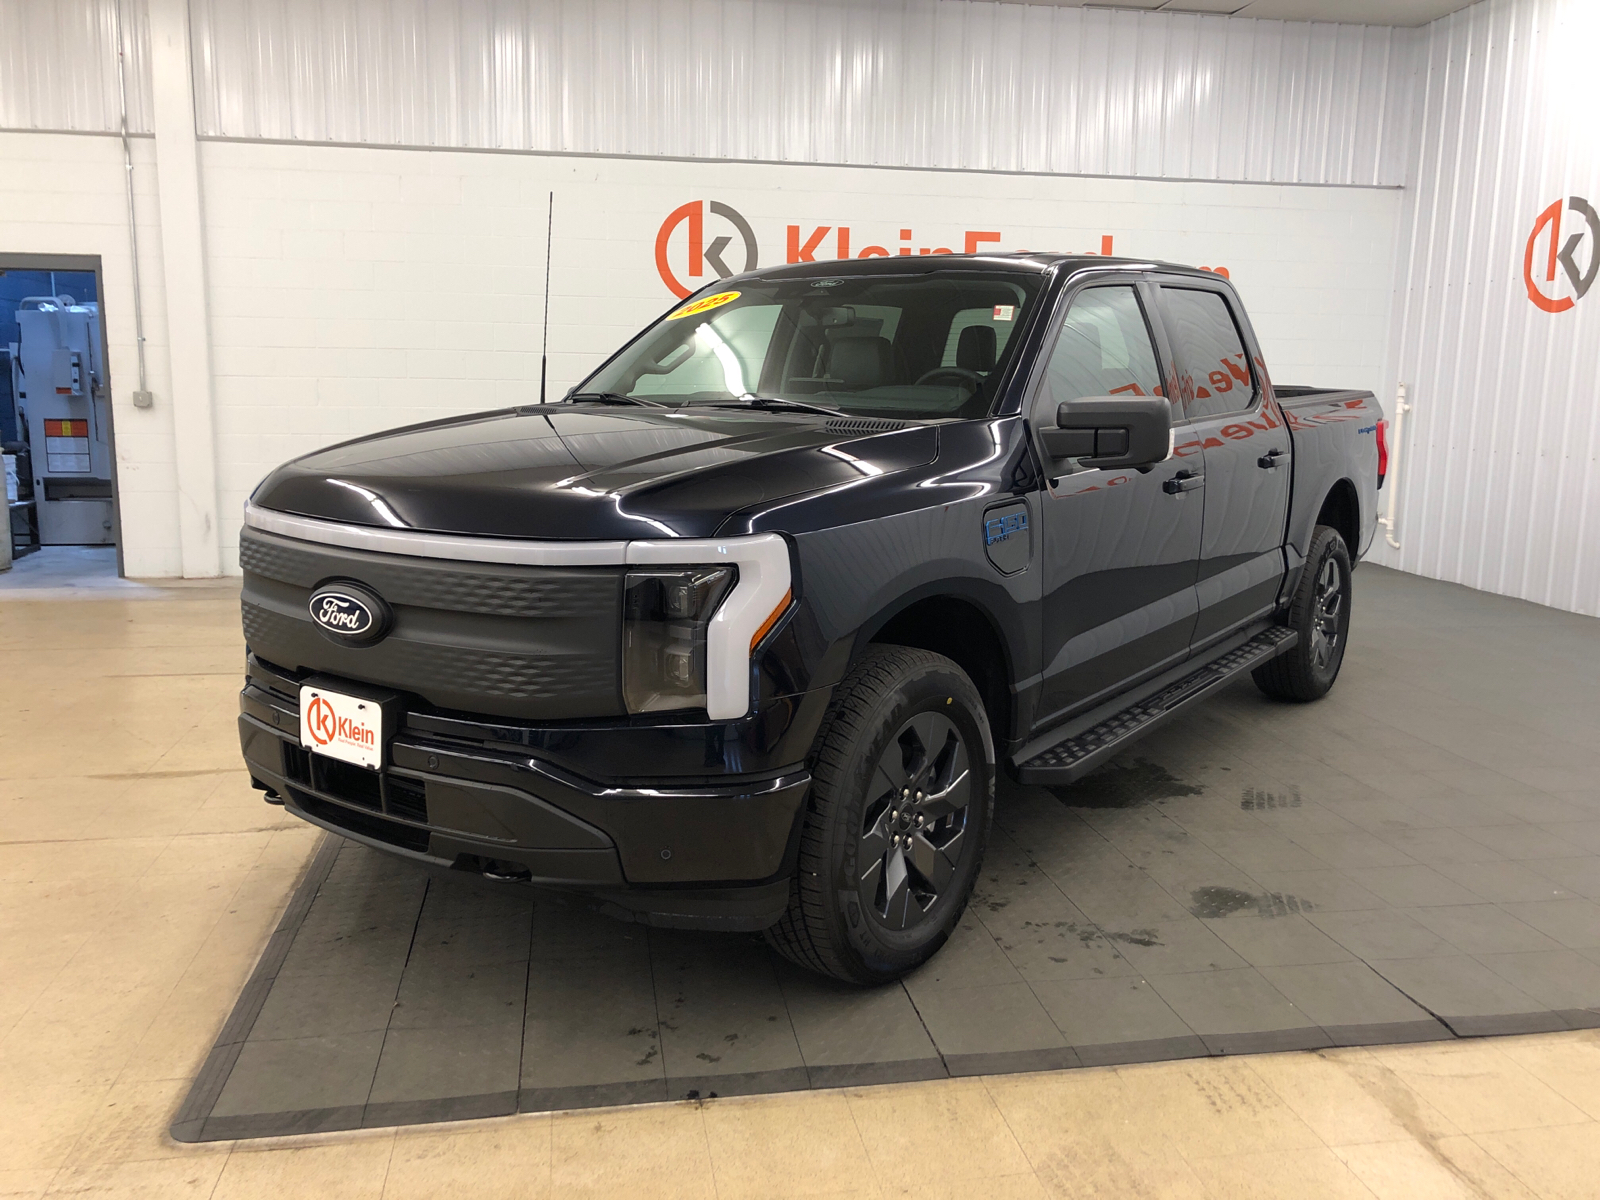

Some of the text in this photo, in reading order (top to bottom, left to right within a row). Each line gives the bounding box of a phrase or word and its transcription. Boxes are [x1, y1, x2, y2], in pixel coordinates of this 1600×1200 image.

[672, 293, 735, 318] 2025
[319, 597, 361, 629] Ford
[338, 716, 374, 745] Klein
